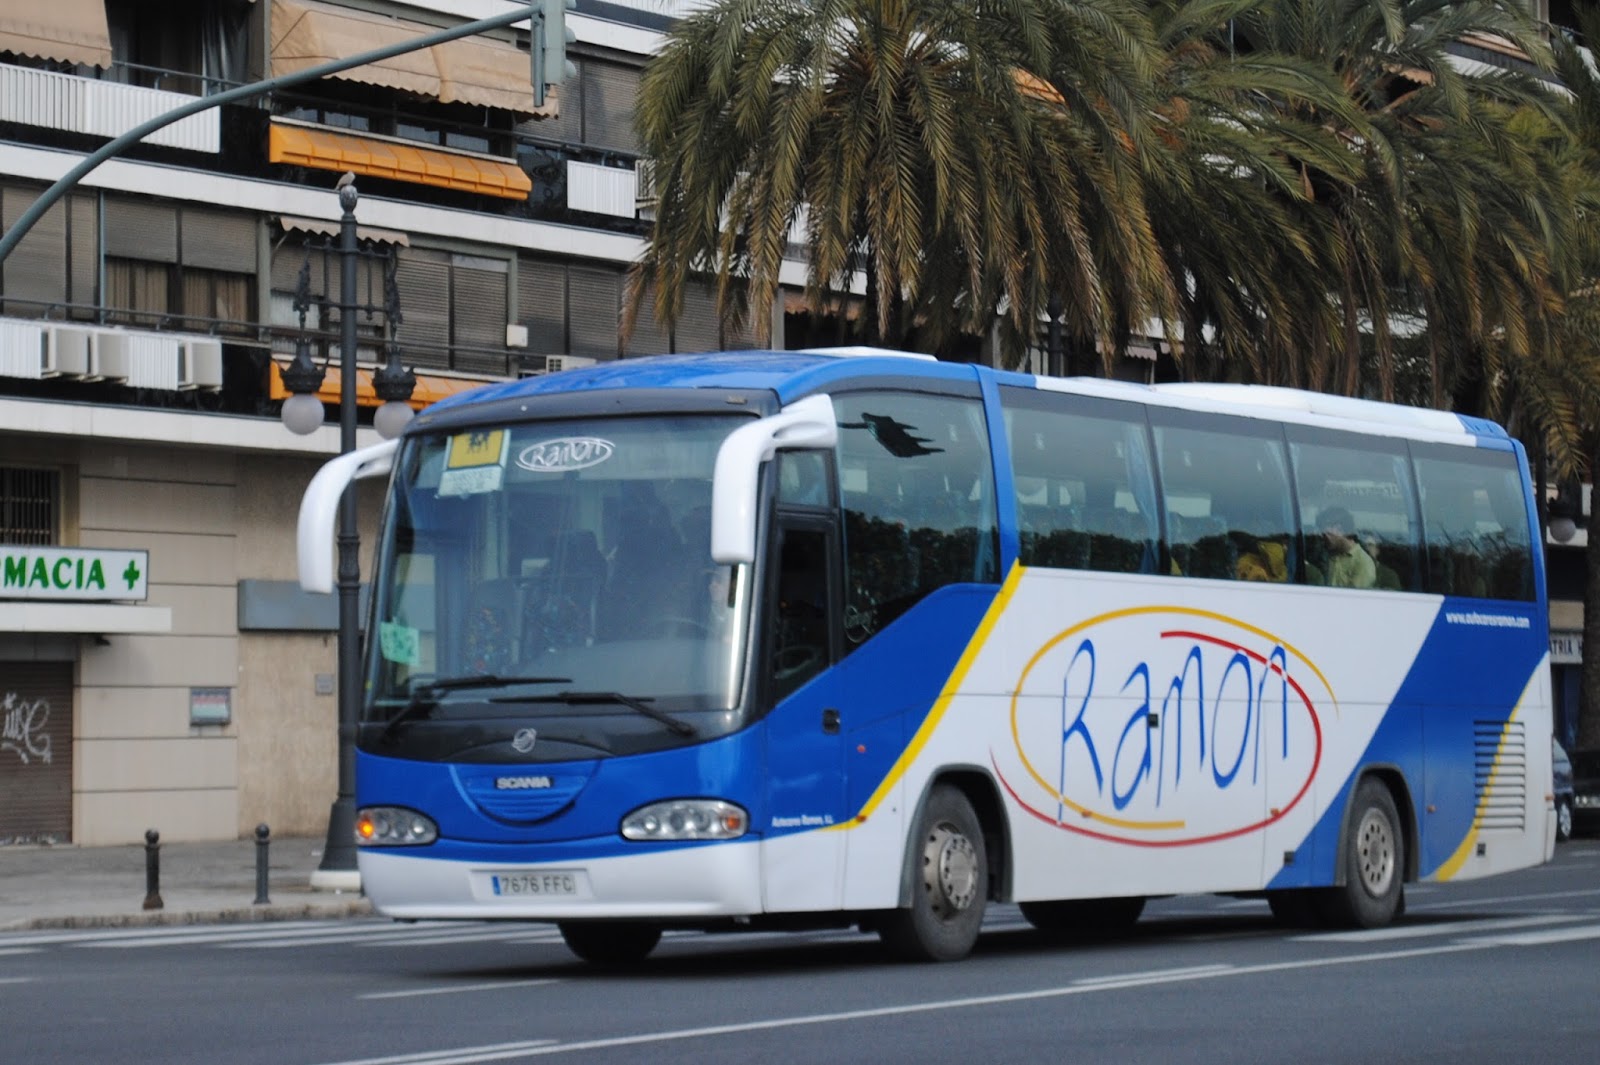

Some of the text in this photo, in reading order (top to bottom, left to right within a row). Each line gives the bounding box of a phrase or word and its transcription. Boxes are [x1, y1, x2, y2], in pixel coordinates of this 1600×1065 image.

[0, 556, 106, 590] MACIA
[495, 776, 551, 790] SCANIA
[501, 875, 574, 893] 7676 FFC
